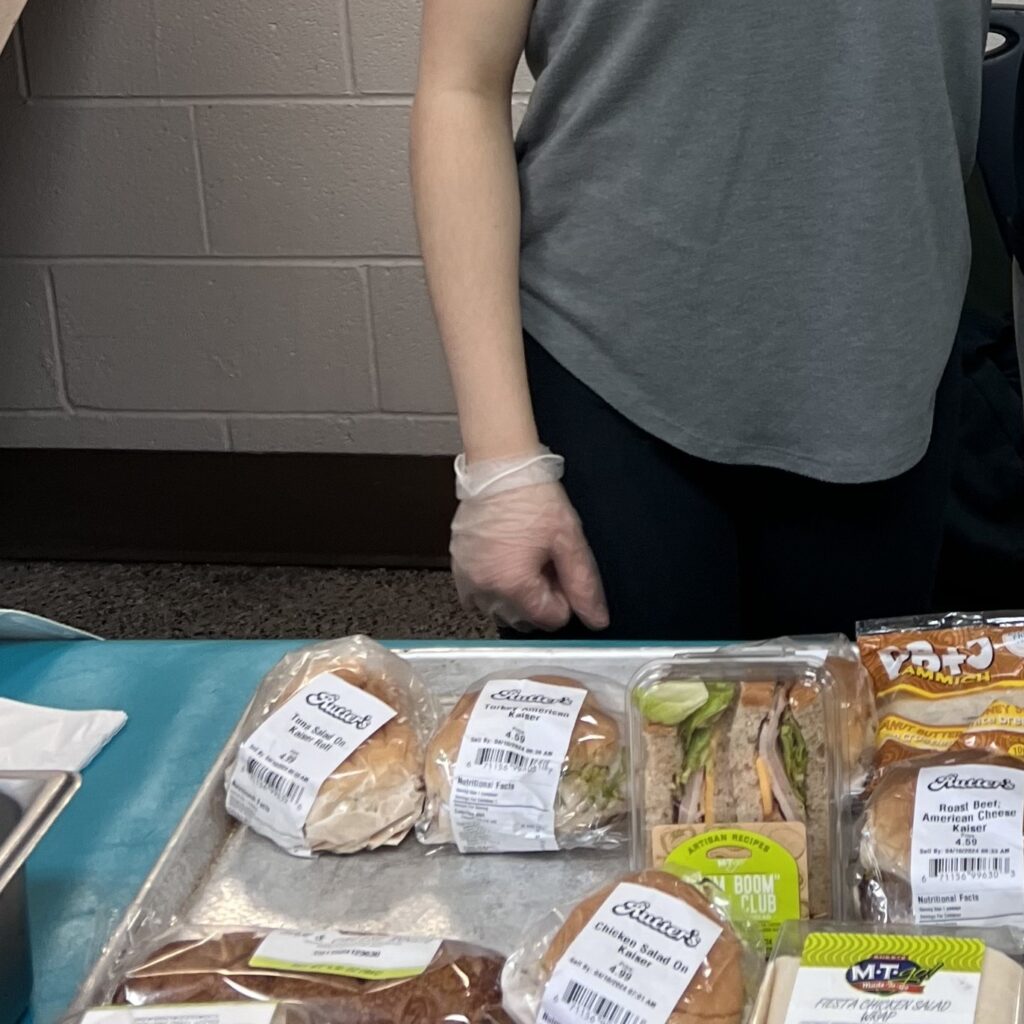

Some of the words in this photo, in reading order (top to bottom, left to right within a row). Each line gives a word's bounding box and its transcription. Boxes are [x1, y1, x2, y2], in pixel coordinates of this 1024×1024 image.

[901, 664, 991, 685] AMMICH
[490, 688, 574, 706] Rutter's
[306, 691, 373, 730] Rutter's
[508, 711, 541, 721] Kaiser
[288, 726, 313, 746] Kaiser
[314, 739, 333, 752] Roll
[290, 713, 311, 730] Tuna
[310, 726, 333, 742] Salad
[333, 735, 346, 748] On
[928, 773, 1015, 792] Rutter's
[922, 813, 974, 823] American
[978, 810, 1016, 821] Cheese
[939, 802, 969, 812] Roast
[953, 824, 987, 833] Kaiser
[687, 833, 728, 855] ARTISAN
[732, 833, 770, 853] RECIPES
[741, 894, 777, 914] CLUB
[917, 894, 957, 904] Nutritional
[959, 893, 980, 902] Facts
[612, 900, 701, 948] Rutter's
[594, 921, 637, 949] Chicken
[640, 942, 671, 966] Salad
[673, 960, 689, 974] On
[617, 947, 653, 969] Kaiser
[859, 998, 912, 1011] CHICKEN
[911, 999, 951, 1012] SALAD
[860, 1011, 898, 1023] WRAP
